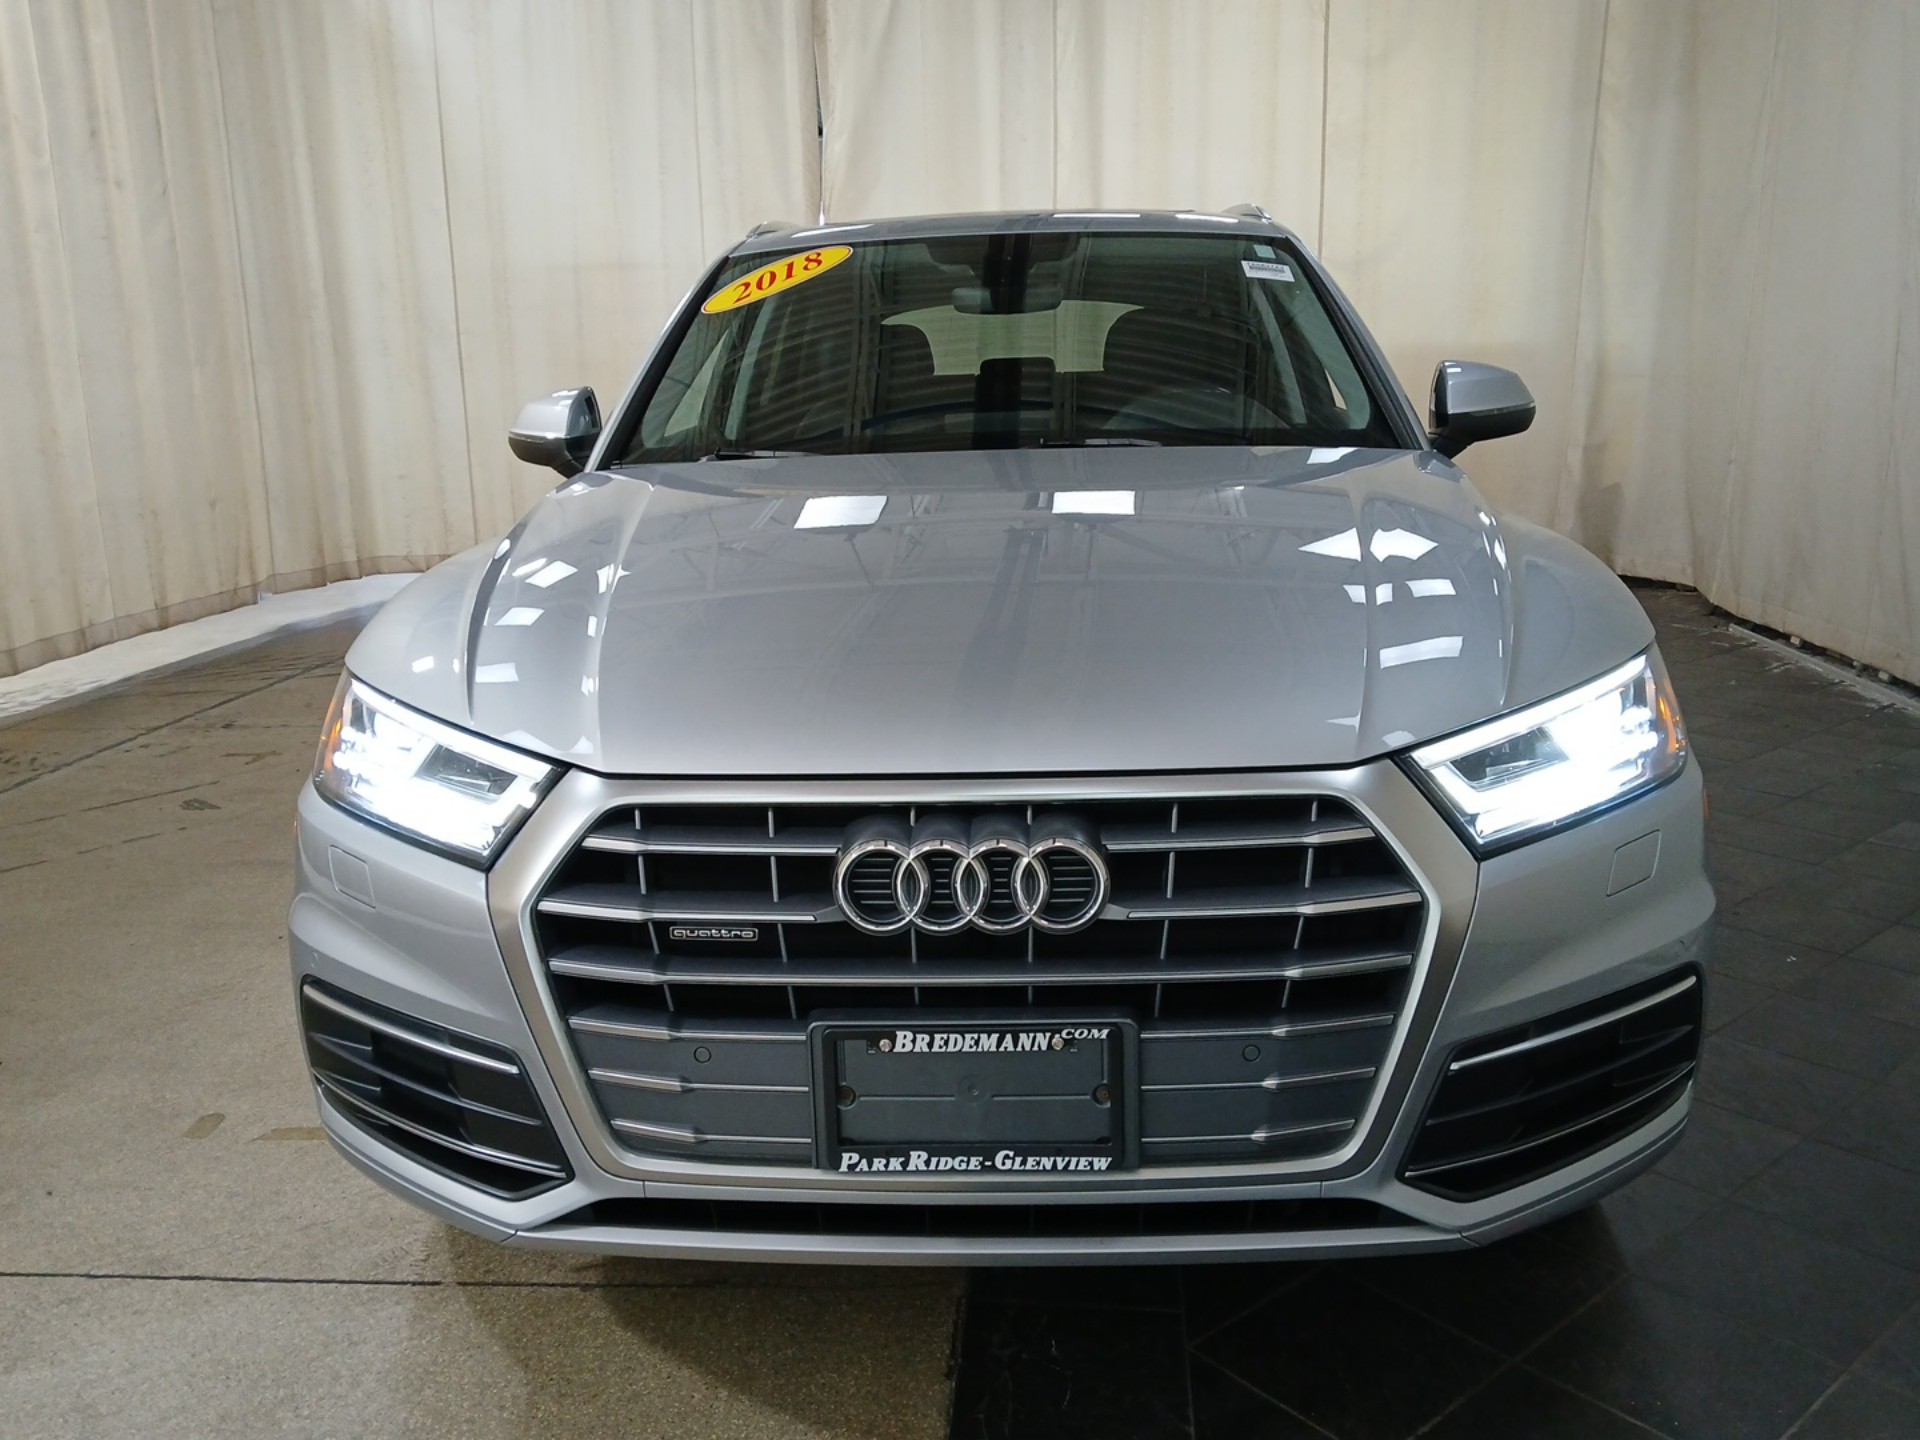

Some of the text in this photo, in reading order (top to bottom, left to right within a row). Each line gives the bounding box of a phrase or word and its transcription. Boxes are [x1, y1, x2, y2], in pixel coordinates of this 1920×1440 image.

[733, 251, 823, 304] 2018
[673, 929, 754, 939] quattro
[838, 1152, 905, 1172] PARK
